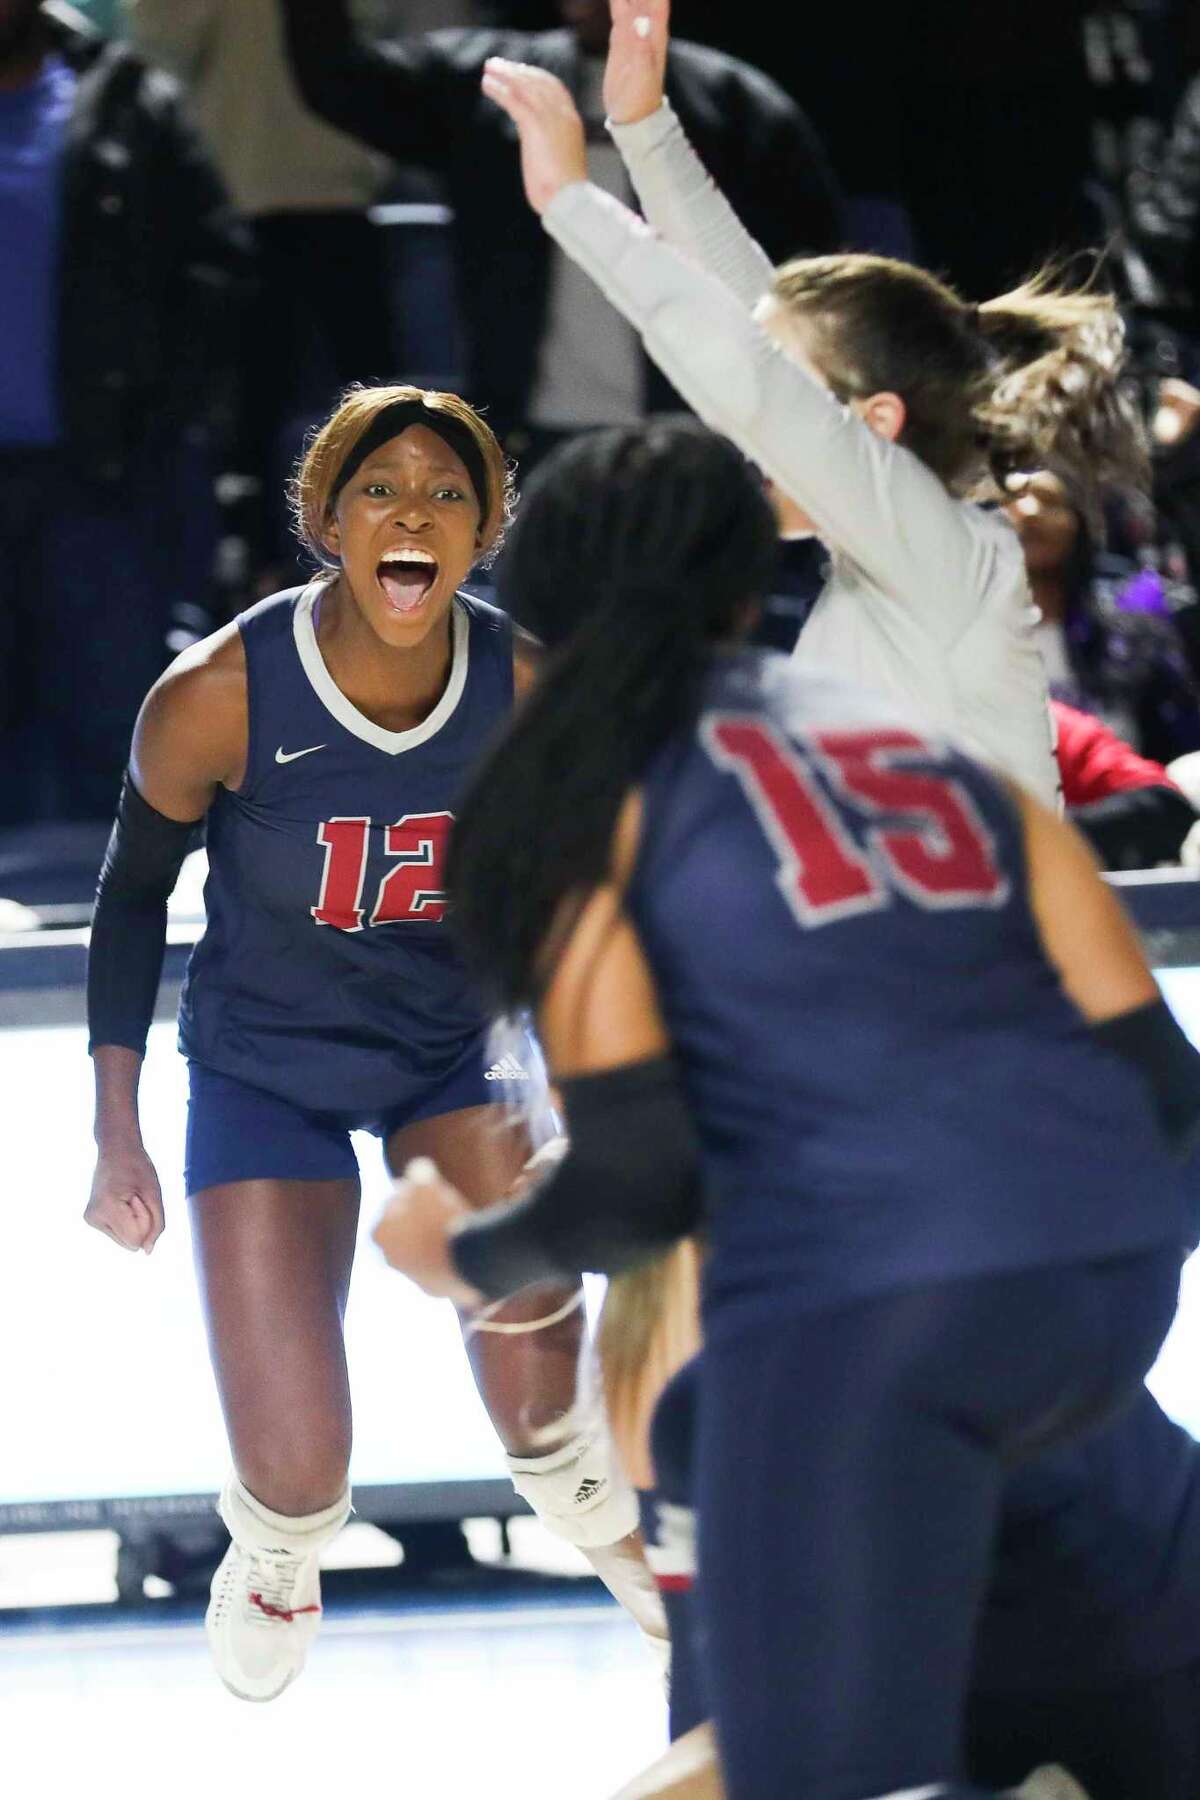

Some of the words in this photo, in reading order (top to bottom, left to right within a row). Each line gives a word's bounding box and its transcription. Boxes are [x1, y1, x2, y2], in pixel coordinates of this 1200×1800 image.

[310, 811, 455, 932] 12
[700, 711, 1010, 928] 15
[574, 1478, 607, 1504] adid
